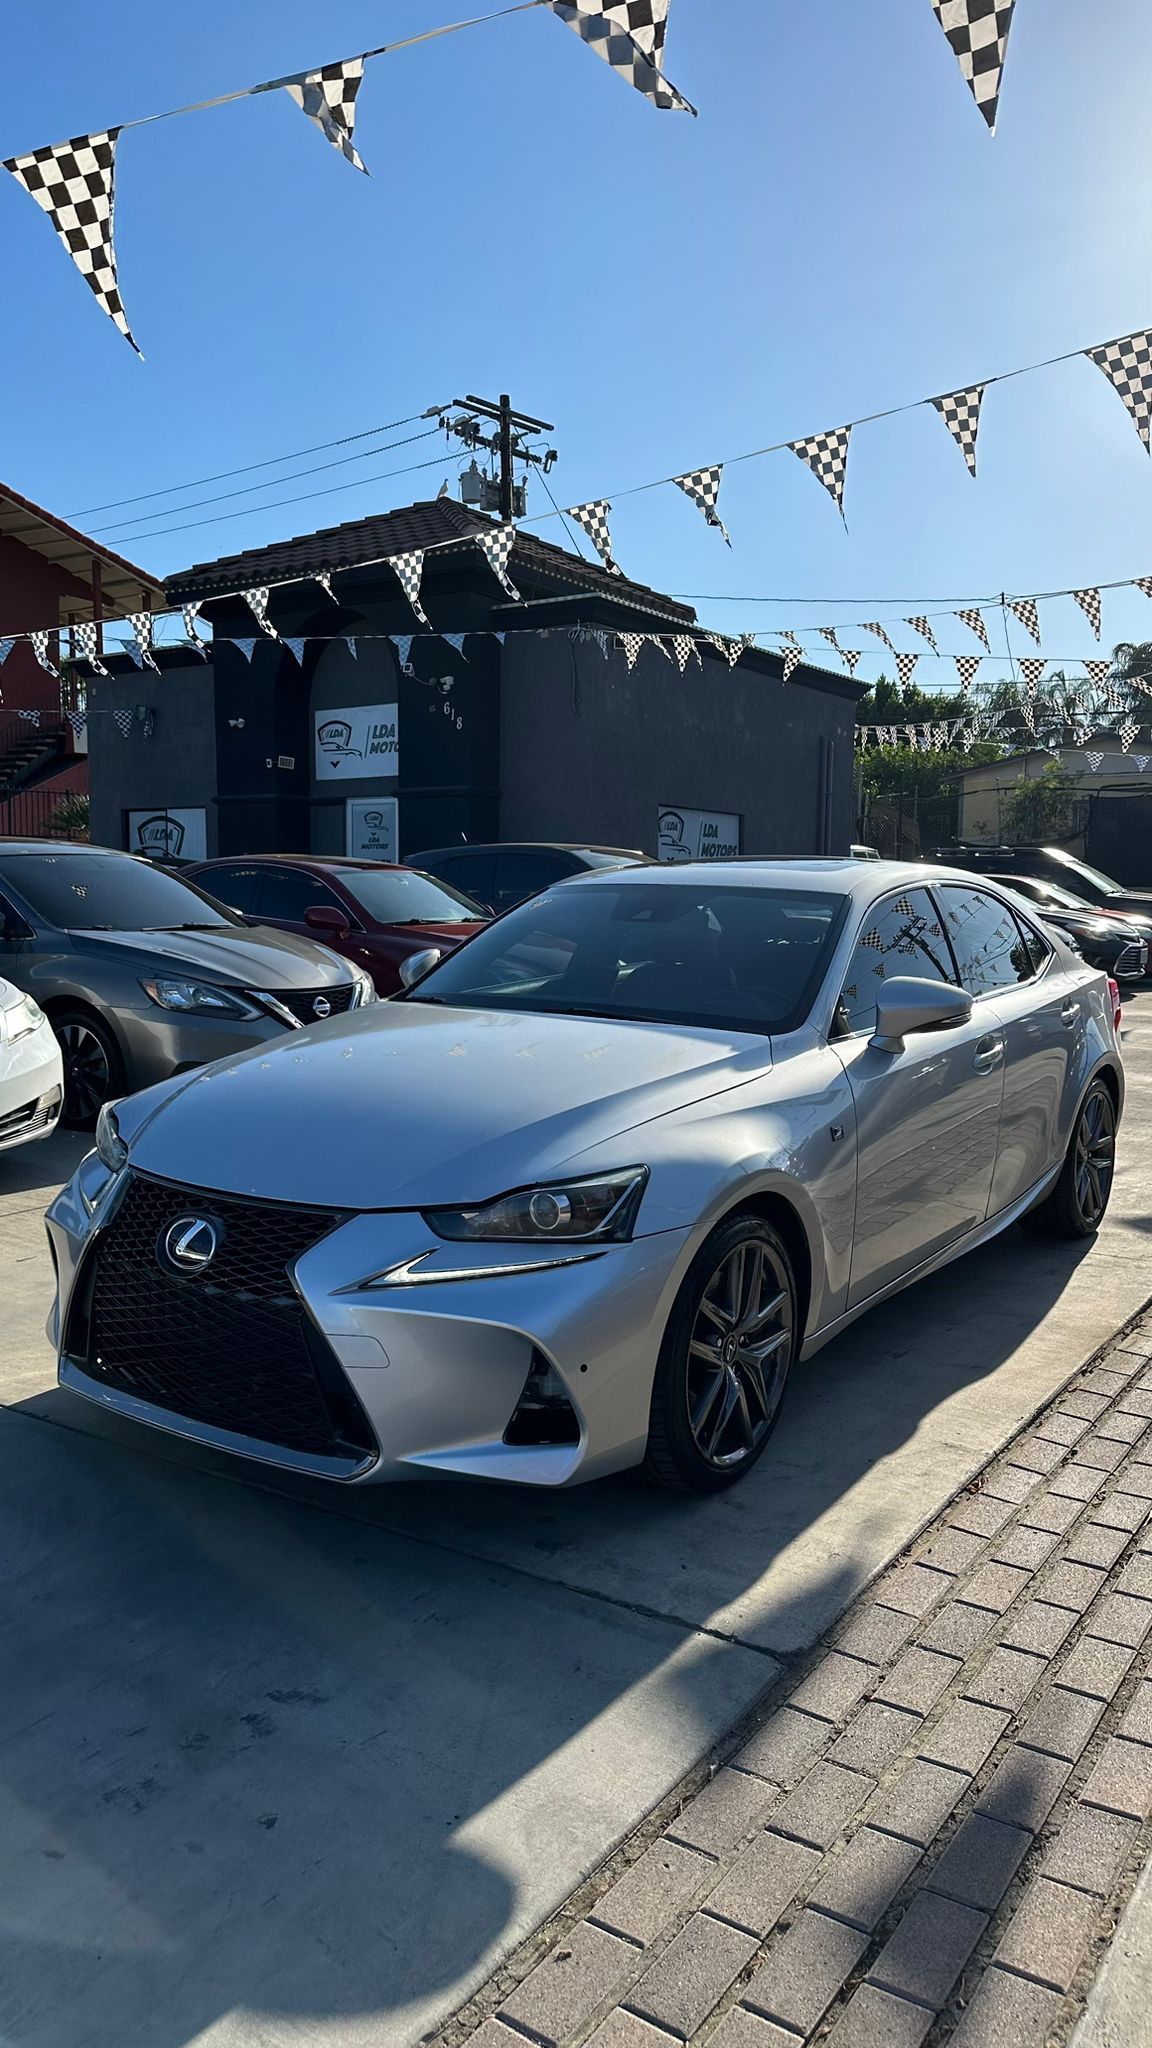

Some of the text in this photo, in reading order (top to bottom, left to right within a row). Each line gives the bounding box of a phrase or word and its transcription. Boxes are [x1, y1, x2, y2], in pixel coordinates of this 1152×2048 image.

[443, 701, 463, 730] 618
[372, 723, 396, 739] LDA
[369, 740, 400, 755] MOTO
[702, 823, 719, 839] LDA
[701, 842, 738, 857] MOTORS
